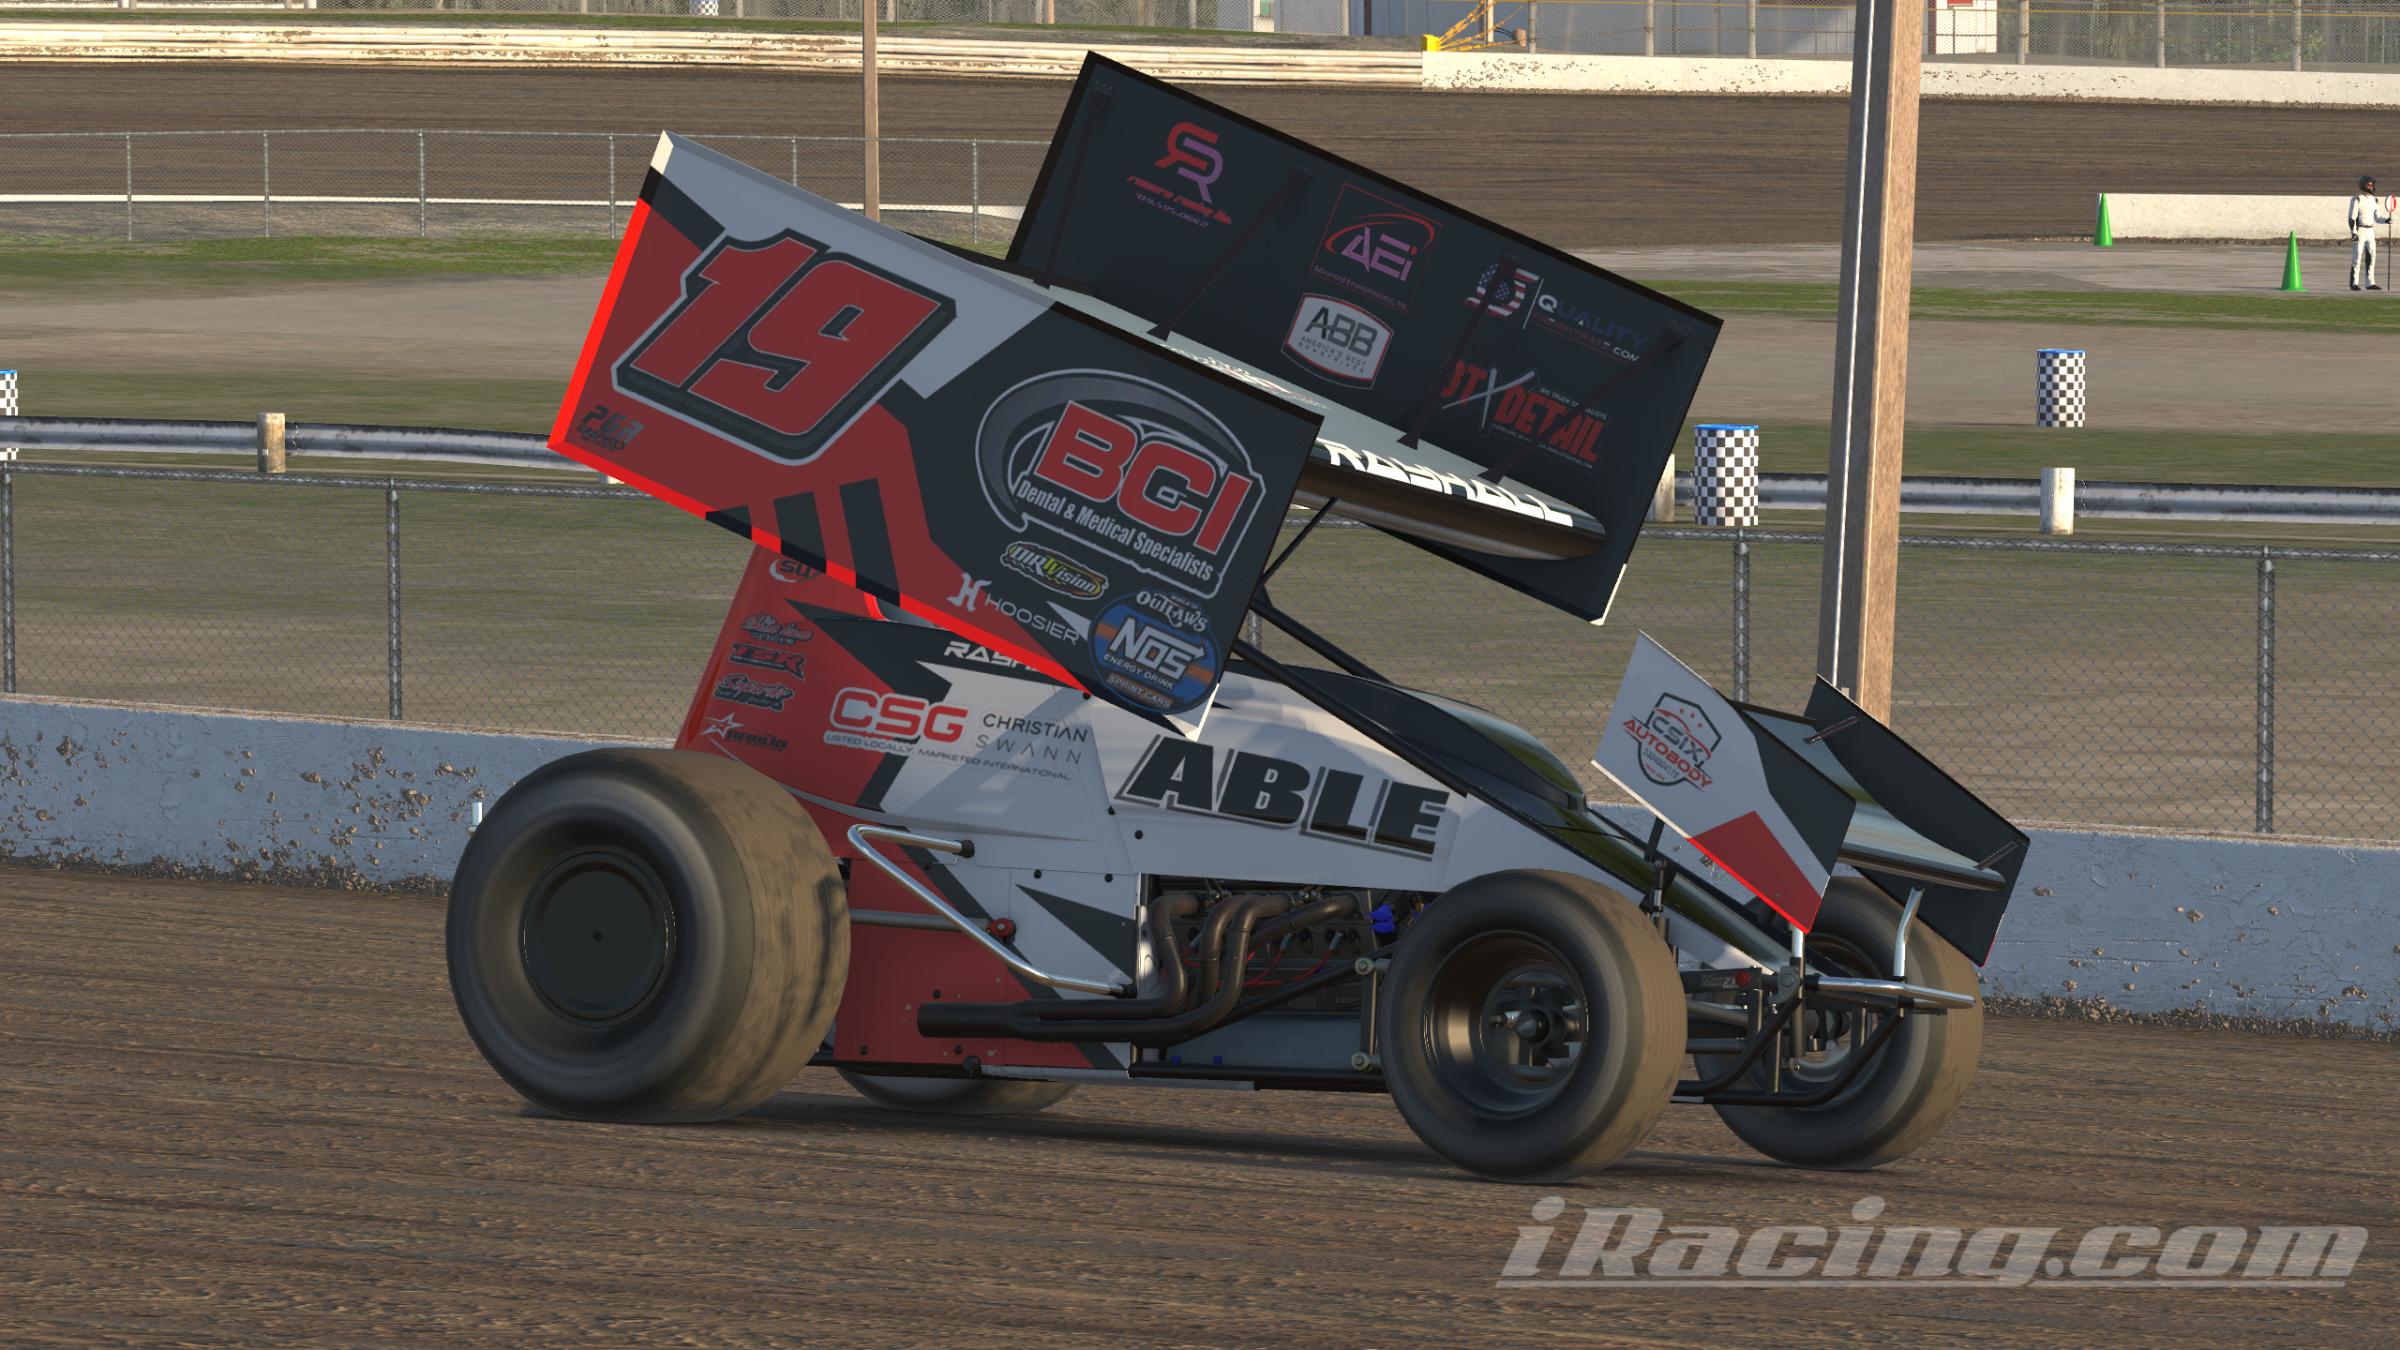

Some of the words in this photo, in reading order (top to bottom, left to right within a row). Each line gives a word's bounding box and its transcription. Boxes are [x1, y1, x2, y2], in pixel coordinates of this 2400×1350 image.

[618, 230, 955, 458] 19
[1304, 306, 1379, 357] ABB
[1538, 293, 1649, 349] QUALITY
[1493, 384, 1605, 464] DETAIL
[1016, 479, 1067, 516] Dental
[1063, 504, 1076, 522] &
[1075, 506, 1135, 547] Medical
[1132, 531, 1214, 582] Specialists
[985, 593, 1081, 647] HOOSIER
[1136, 590, 1208, 633] OUTLAWS
[1103, 652, 1145, 676] ENERGY
[1143, 671, 1175, 691] DRINK
[1109, 617, 1205, 680] NOS
[832, 688, 969, 744] CSG
[1109, 674, 1145, 695] SPRINT
[1143, 690, 1170, 708] CARS
[974, 734, 1083, 766] SWANN
[983, 712, 1088, 743] CHRISTIAN
[1623, 718, 1713, 788] AUTOBODY
[1652, 715, 1704, 763] CSIX
[825, 732, 863, 746] LISTED
[917, 748, 981, 766] MARKETED
[982, 758, 1073, 782] INTERNATIONAL
[1117, 735, 1450, 860] ABLE
